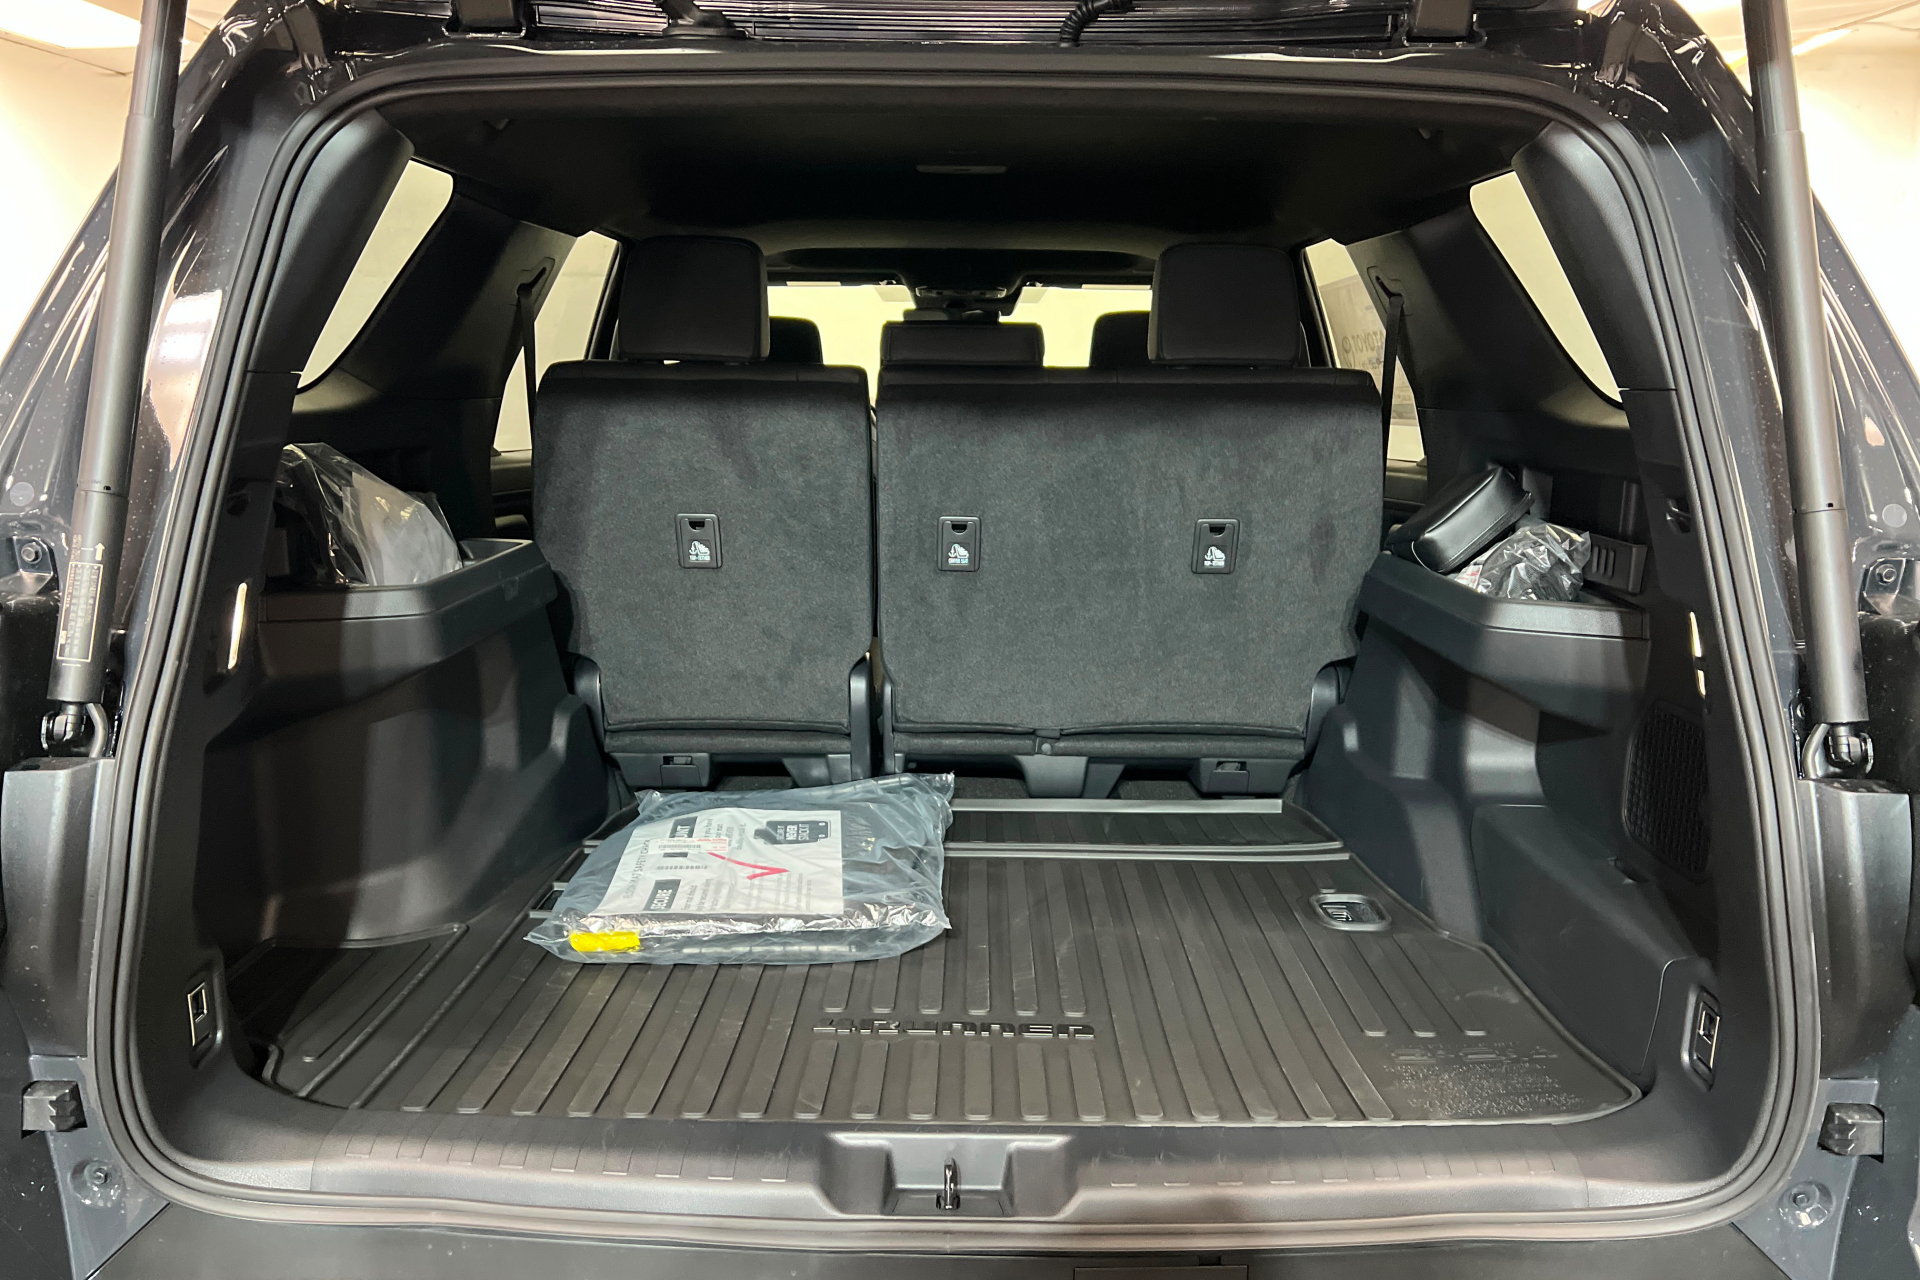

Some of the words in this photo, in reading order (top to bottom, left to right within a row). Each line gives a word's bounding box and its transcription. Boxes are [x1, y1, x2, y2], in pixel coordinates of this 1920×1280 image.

[633, 855, 647, 872] SAFETY
[650, 888, 673, 910] SECURE
[812, 1017, 1096, 1040] 4RUNNER
